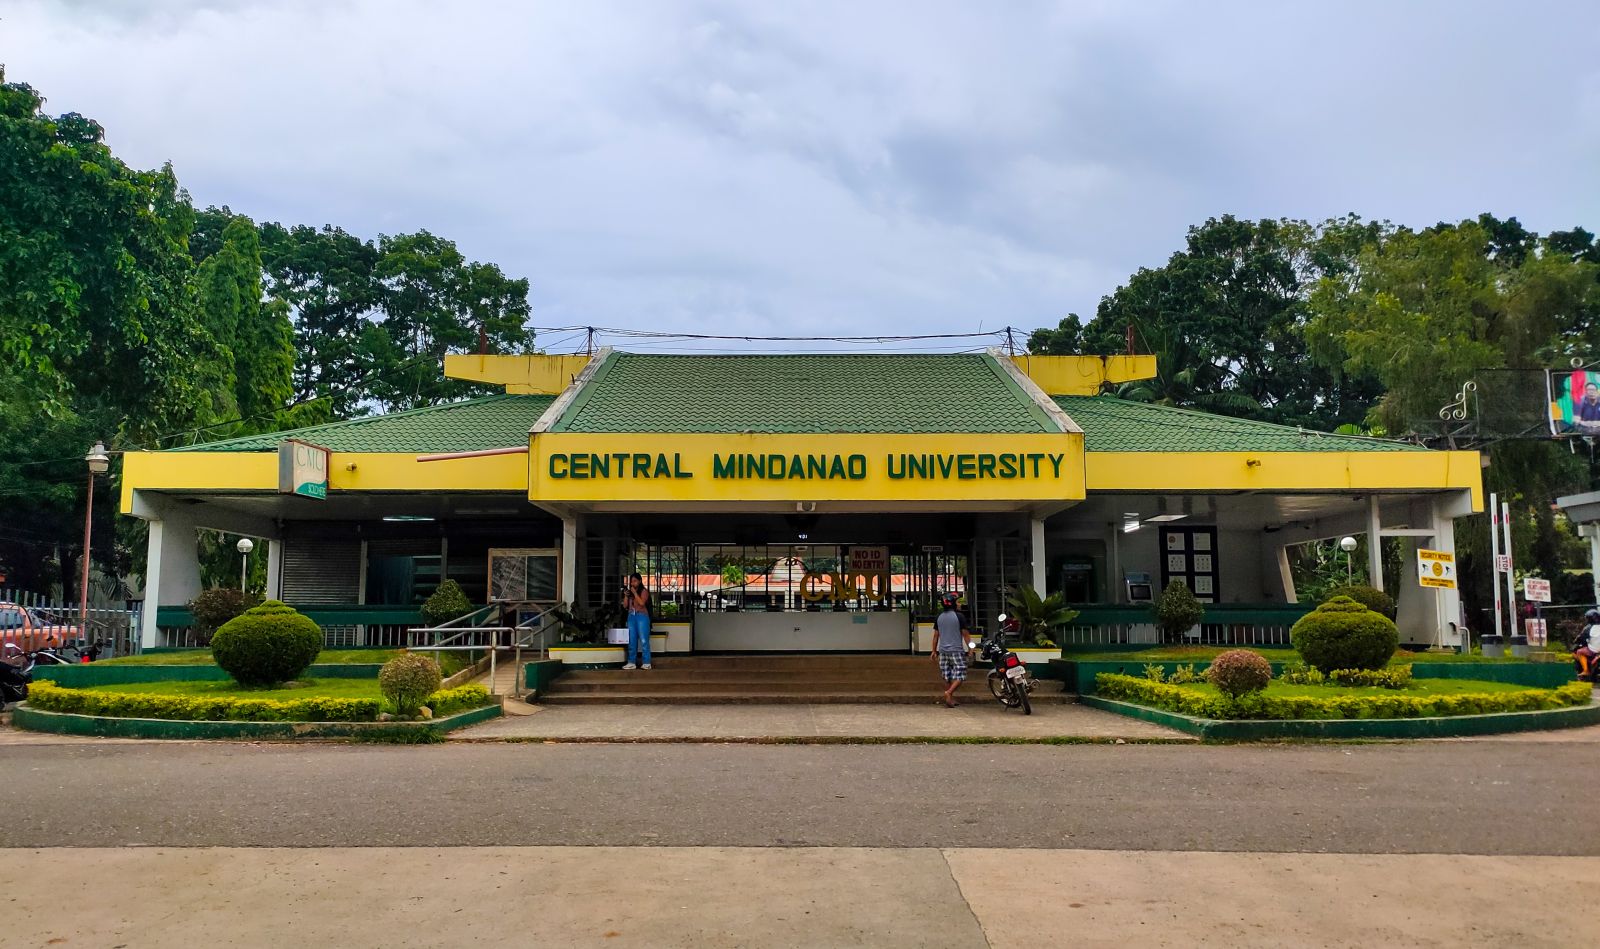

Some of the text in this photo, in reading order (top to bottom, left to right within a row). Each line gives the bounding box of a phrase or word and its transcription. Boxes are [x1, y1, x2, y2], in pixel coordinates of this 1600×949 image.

[549, 453, 1065, 480] CENTRAL MINDANAO UNIVERSITY
[854, 550, 881, 560] NO ID
[852, 560, 885, 570] NO ENTRY
[800, 571, 888, 602] CMU
